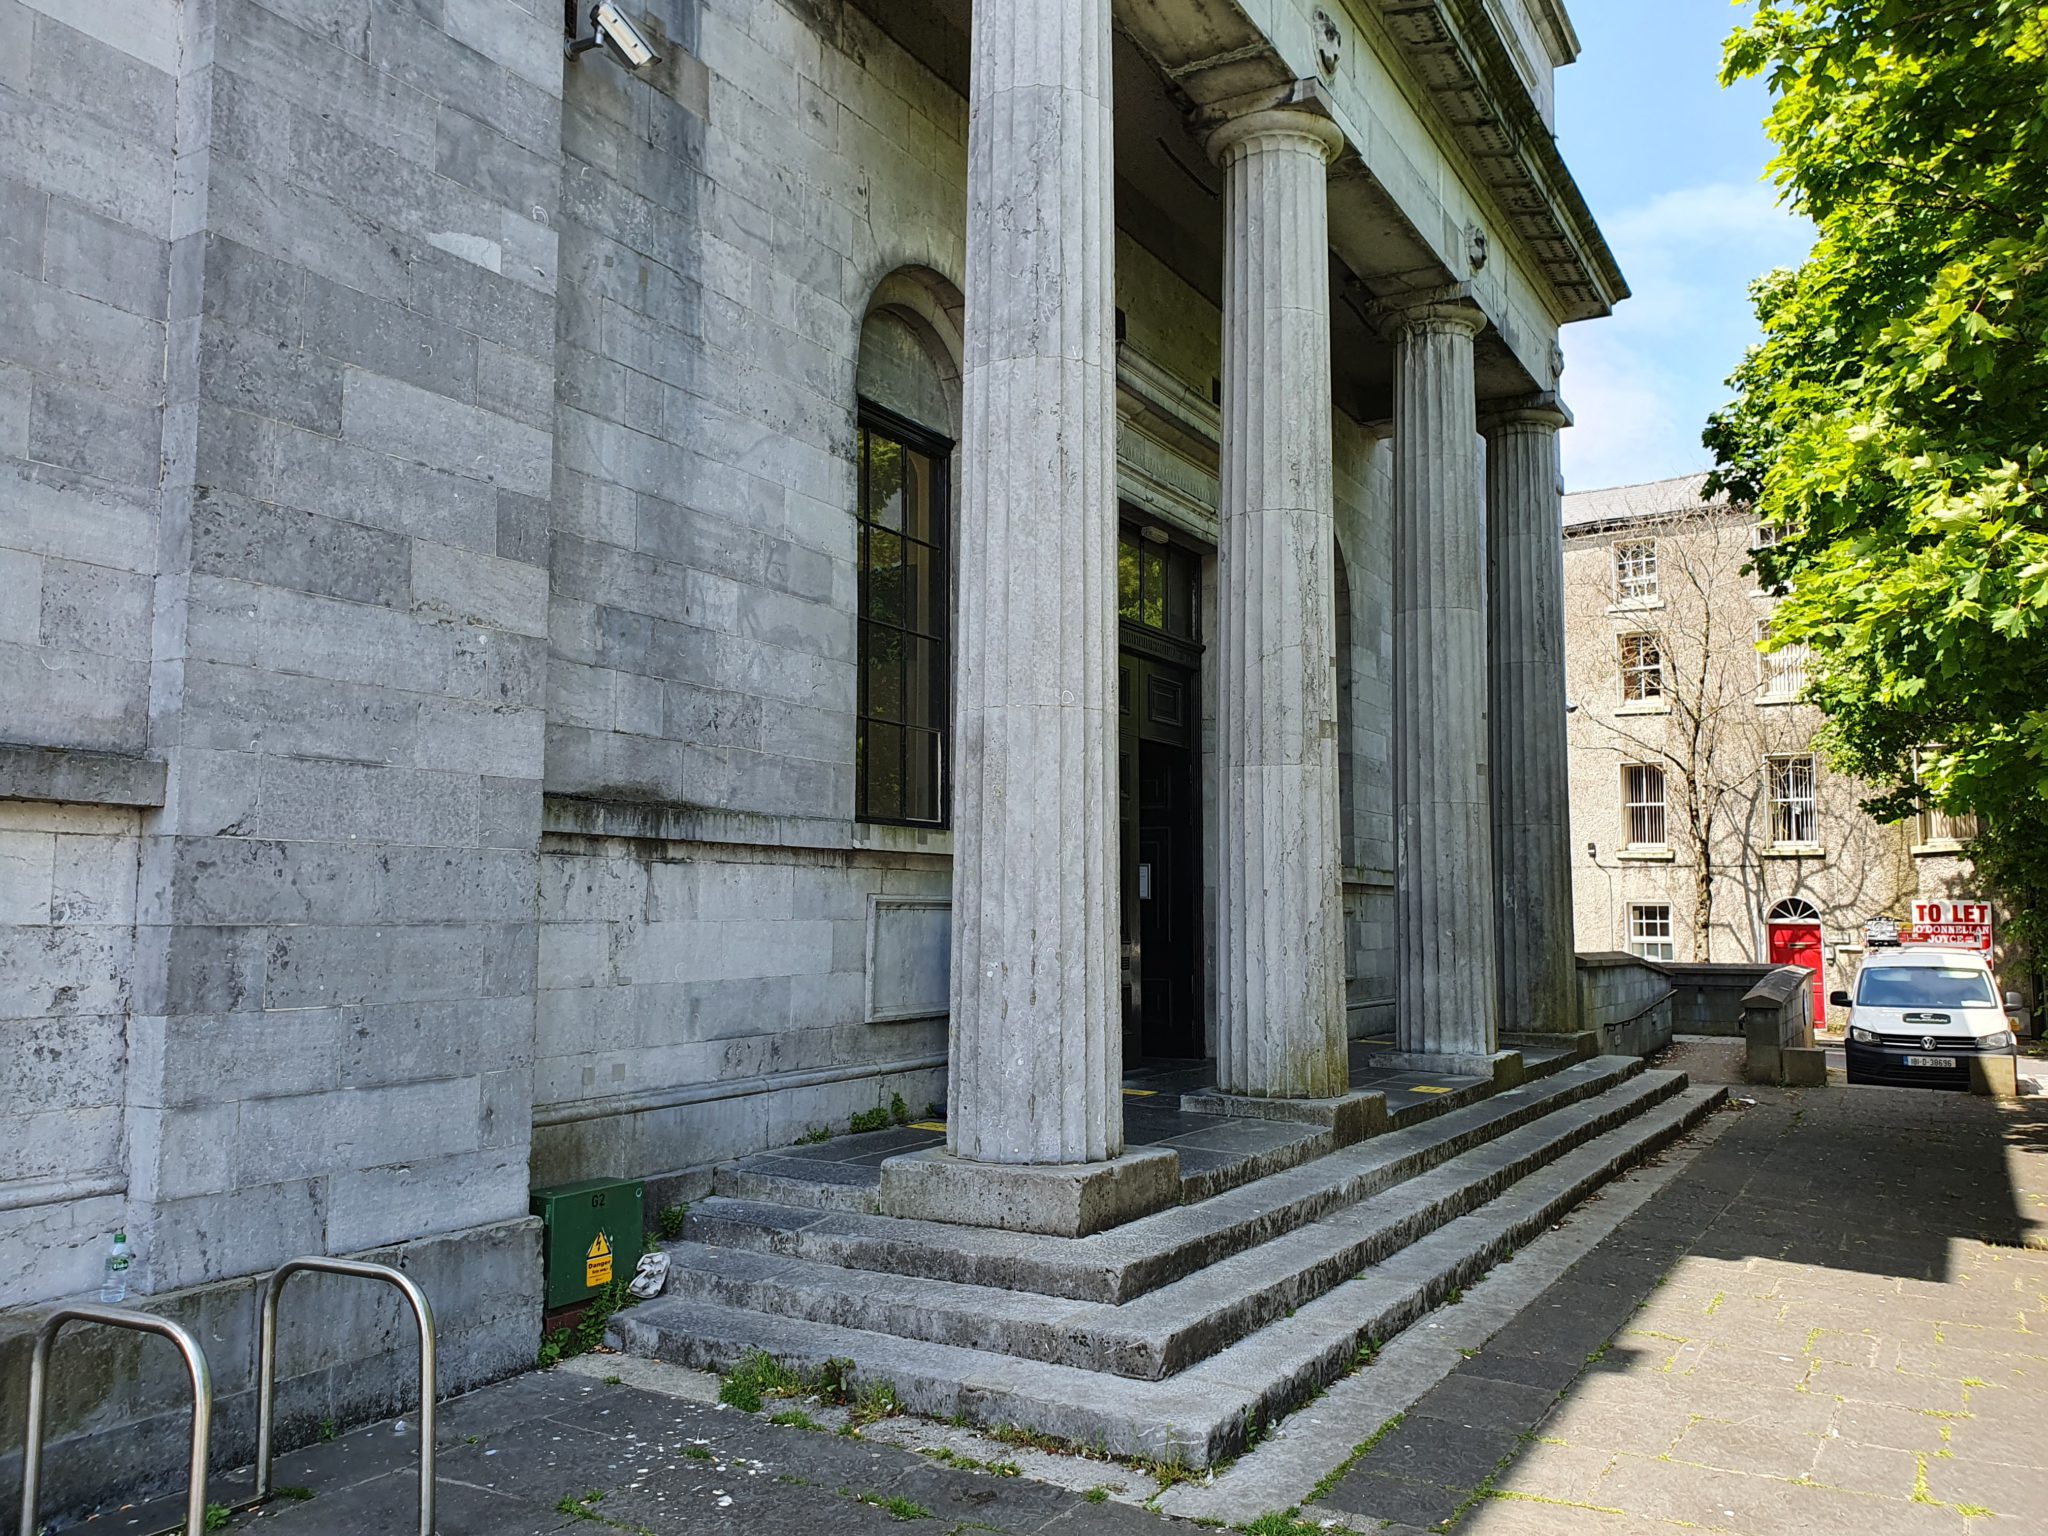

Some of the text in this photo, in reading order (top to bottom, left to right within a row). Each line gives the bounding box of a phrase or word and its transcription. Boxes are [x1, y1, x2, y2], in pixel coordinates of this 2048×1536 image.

[1916, 904, 1988, 923] TO LET
[1915, 925, 1989, 934] O'DONNELLAN
[1929, 934, 1964, 943] JOYCE
[592, 1193, 605, 1208] G2
[588, 1260, 611, 1269] Danger
